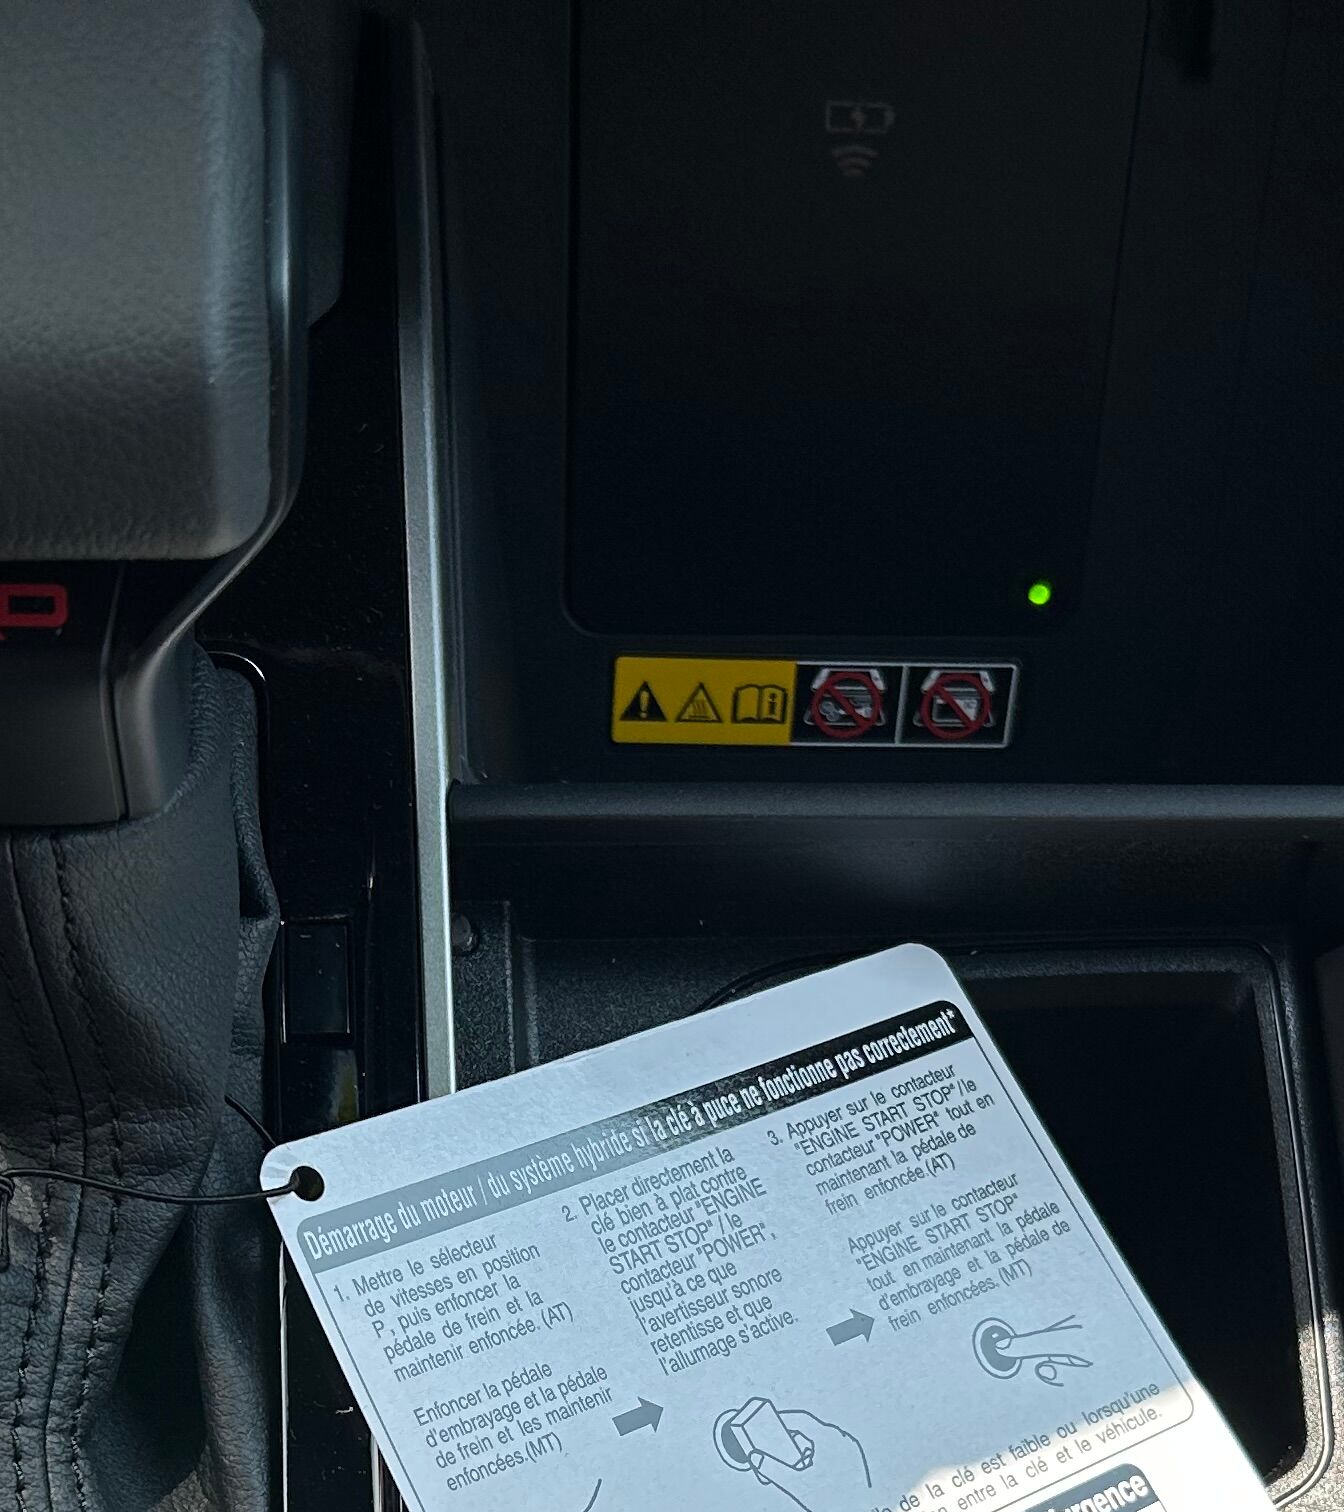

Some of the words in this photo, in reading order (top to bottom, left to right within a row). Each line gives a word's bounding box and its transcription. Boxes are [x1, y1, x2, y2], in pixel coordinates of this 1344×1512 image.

[302, 1211, 397, 1260] Démarrage
[396, 1200, 421, 1229] du
[419, 1184, 477, 1221] moteur
[487, 1171, 511, 1198] du
[508, 1152, 574, 1194] système
[570, 1128, 632, 1171] hybride
[630, 1118, 650, 1147] si
[643, 1115, 668, 1141] la
[665, 1103, 692, 1135] clé
[686, 1100, 705, 1126] à
[701, 1092, 742, 1128] puce
[738, 1085, 763, 1109] ne
[757, 1058, 837, 1101] fonctionne
[833, 1047, 865, 1079] pas
[332, 1284, 350, 1302] 1.
[351, 1267, 403, 1296] Mettre
[405, 1258, 424, 1277] le
[429, 1233, 497, 1269] sélecteur
[363, 1298, 385, 1317] de
[389, 1275, 453, 1308] vitesses
[456, 1266, 478, 1284] en
[481, 1244, 540, 1278] position
[370, 1319, 395, 1339] P,
[396, 1305, 432, 1333] puis
[434, 1281, 499, 1316] enfoncer
[501, 1273, 521, 1290] la
[382, 1329, 436, 1364] pédale
[441, 1319, 463, 1338] de
[463, 1305, 501, 1330] frein
[505, 1295, 523, 1314] et
[524, 1290, 544, 1307] la
[392, 1343, 463, 1382] maintenir
[468, 1317, 540, 1354] enfoncée.
[540, 1300, 573, 1330] (AT)
[412, 1388, 482, 1426] Enfoncer
[481, 1382, 501, 1399] la
[500, 1361, 552, 1397] pédale
[425, 1400, 521, 1448] d'embrayage
[523, 1390, 541, 1409] et
[537, 1385, 557, 1403] la
[556, 1365, 607, 1399] pédale
[434, 1449, 456, 1469] de
[456, 1435, 494, 1460] frein
[496, 1425, 514, 1444] et
[515, 1416, 542, 1436] les
[544, 1386, 612, 1425] maintenir
[898, 1494, 920, 1512] de
[924, 1483, 945, 1499] la
[951, 1465, 975, 1488] clé
[980, 1452, 1007, 1474] est
[1007, 1433, 1051, 1461] faible
[1055, 1421, 1077, 1439] ou
[1080, 1383, 1160, 1426] lorsqu'une
[957, 1483, 996, 1510] entre
[999, 1474, 1019, 1489] la
[1025, 1455, 1048, 1478] clé
[1055, 1445, 1073, 1463] et
[1073, 1438, 1092, 1453] le
[1094, 1407, 1161, 1443] véhicule.
